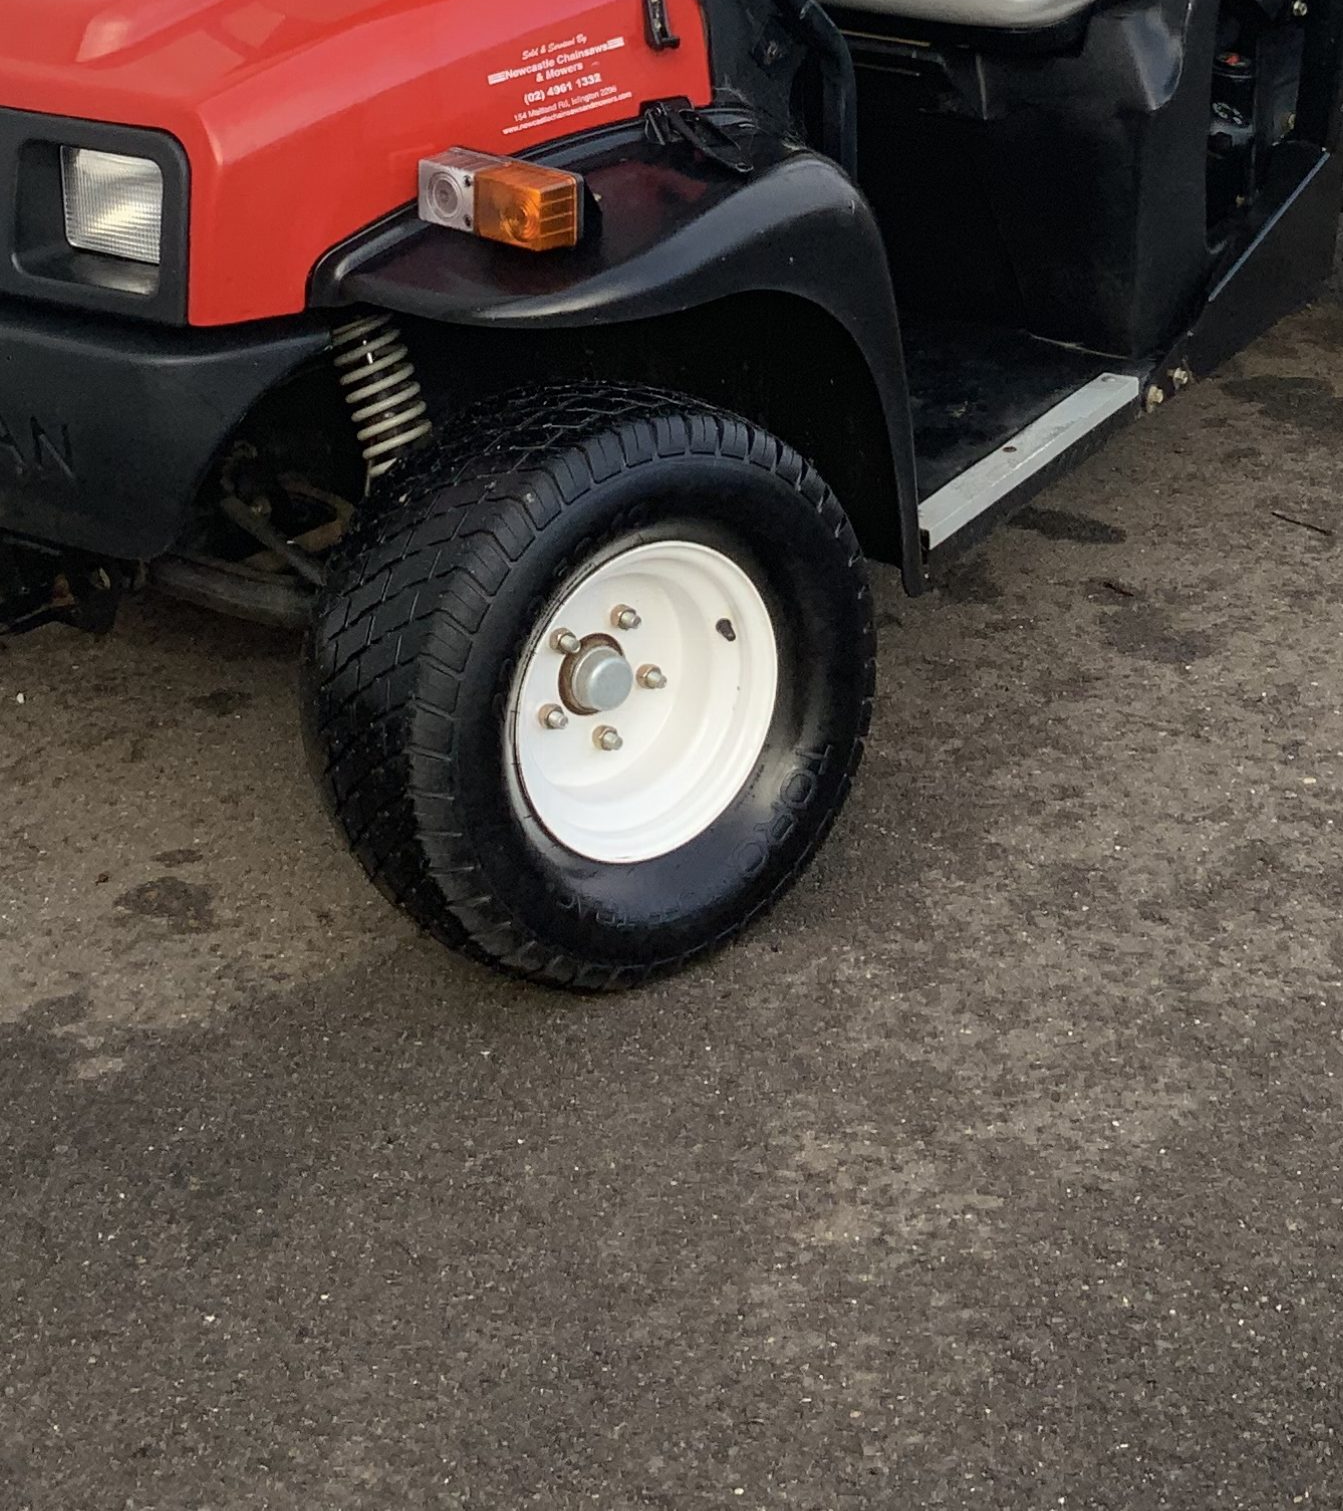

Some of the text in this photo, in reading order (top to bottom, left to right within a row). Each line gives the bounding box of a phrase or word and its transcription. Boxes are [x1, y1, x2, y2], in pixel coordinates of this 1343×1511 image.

[505, 43, 608, 80] Newcastle Chainsaws
[536, 63, 583, 82] & Mowers
[523, 90, 545, 105] (02)
[576, 73, 602, 88] 1332
[734, 743, 834, 878] TORO
